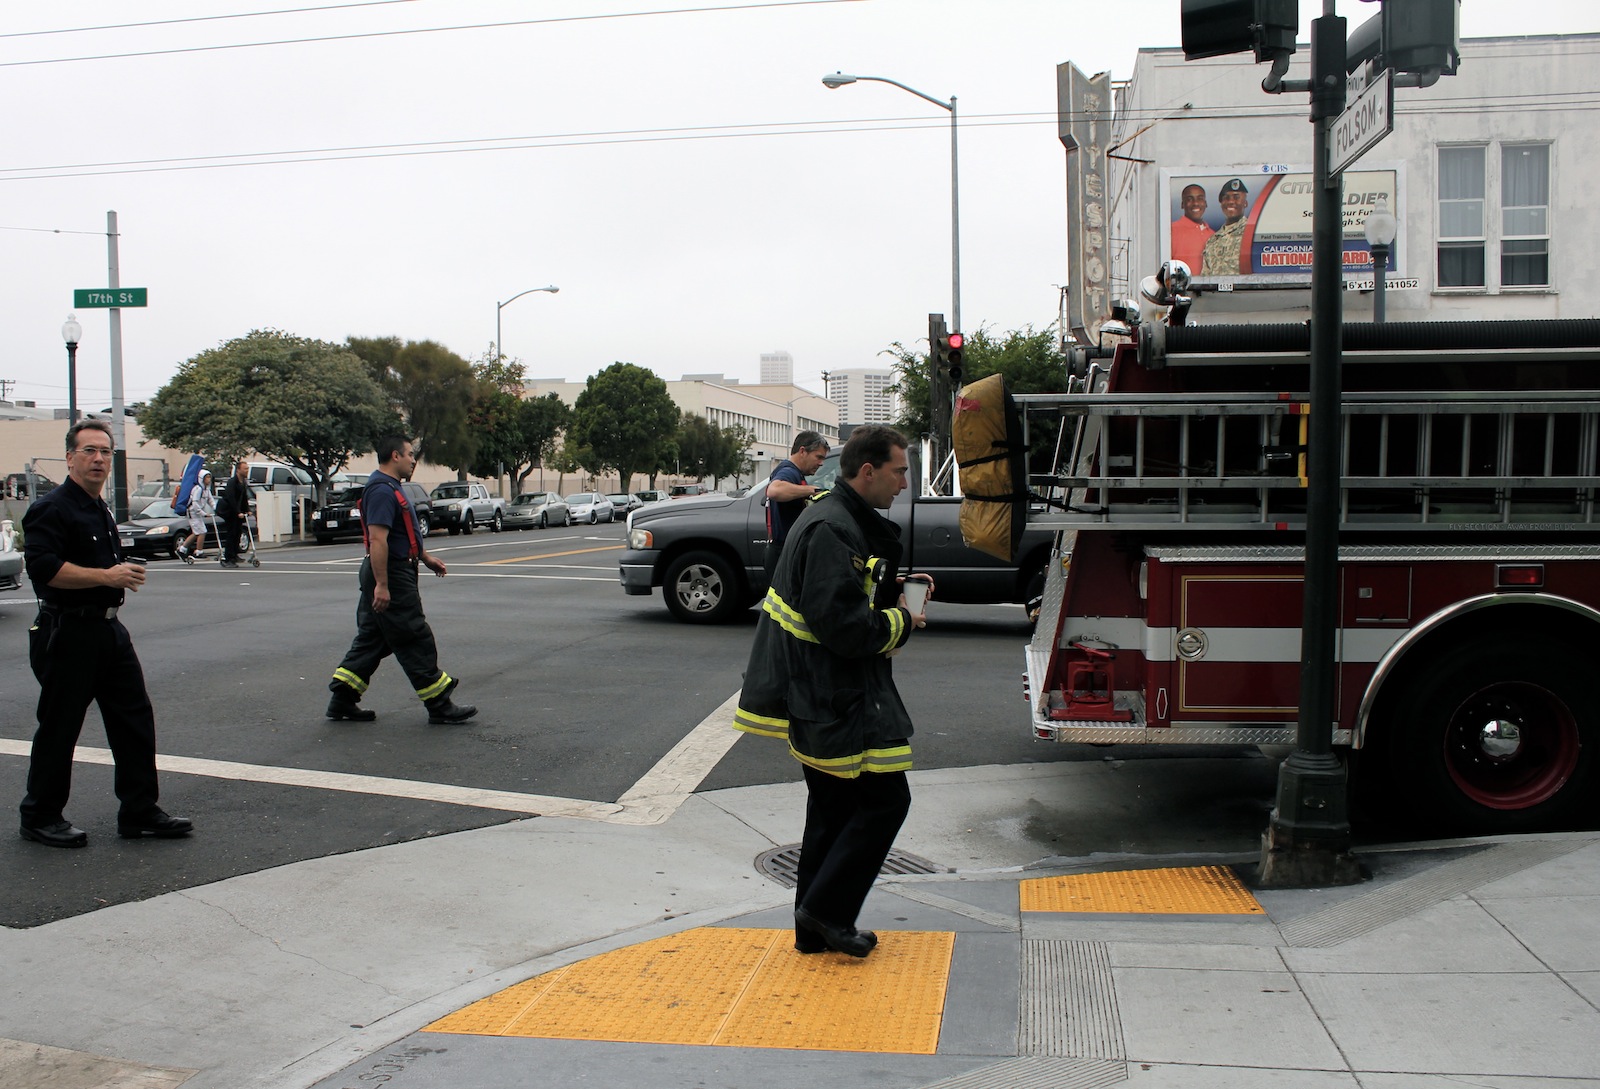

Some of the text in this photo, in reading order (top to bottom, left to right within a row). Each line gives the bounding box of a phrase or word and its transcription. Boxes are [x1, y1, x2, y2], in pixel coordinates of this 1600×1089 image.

[1336, 94, 1376, 158] FOLSOM
[1270, 164, 1288, 172] CBS
[1262, 245, 1313, 253] CALIFORNIA
[1261, 252, 1313, 267] NATIONA
[1342, 250, 1369, 265] ARD
[88, 292, 133, 304] 17th St
